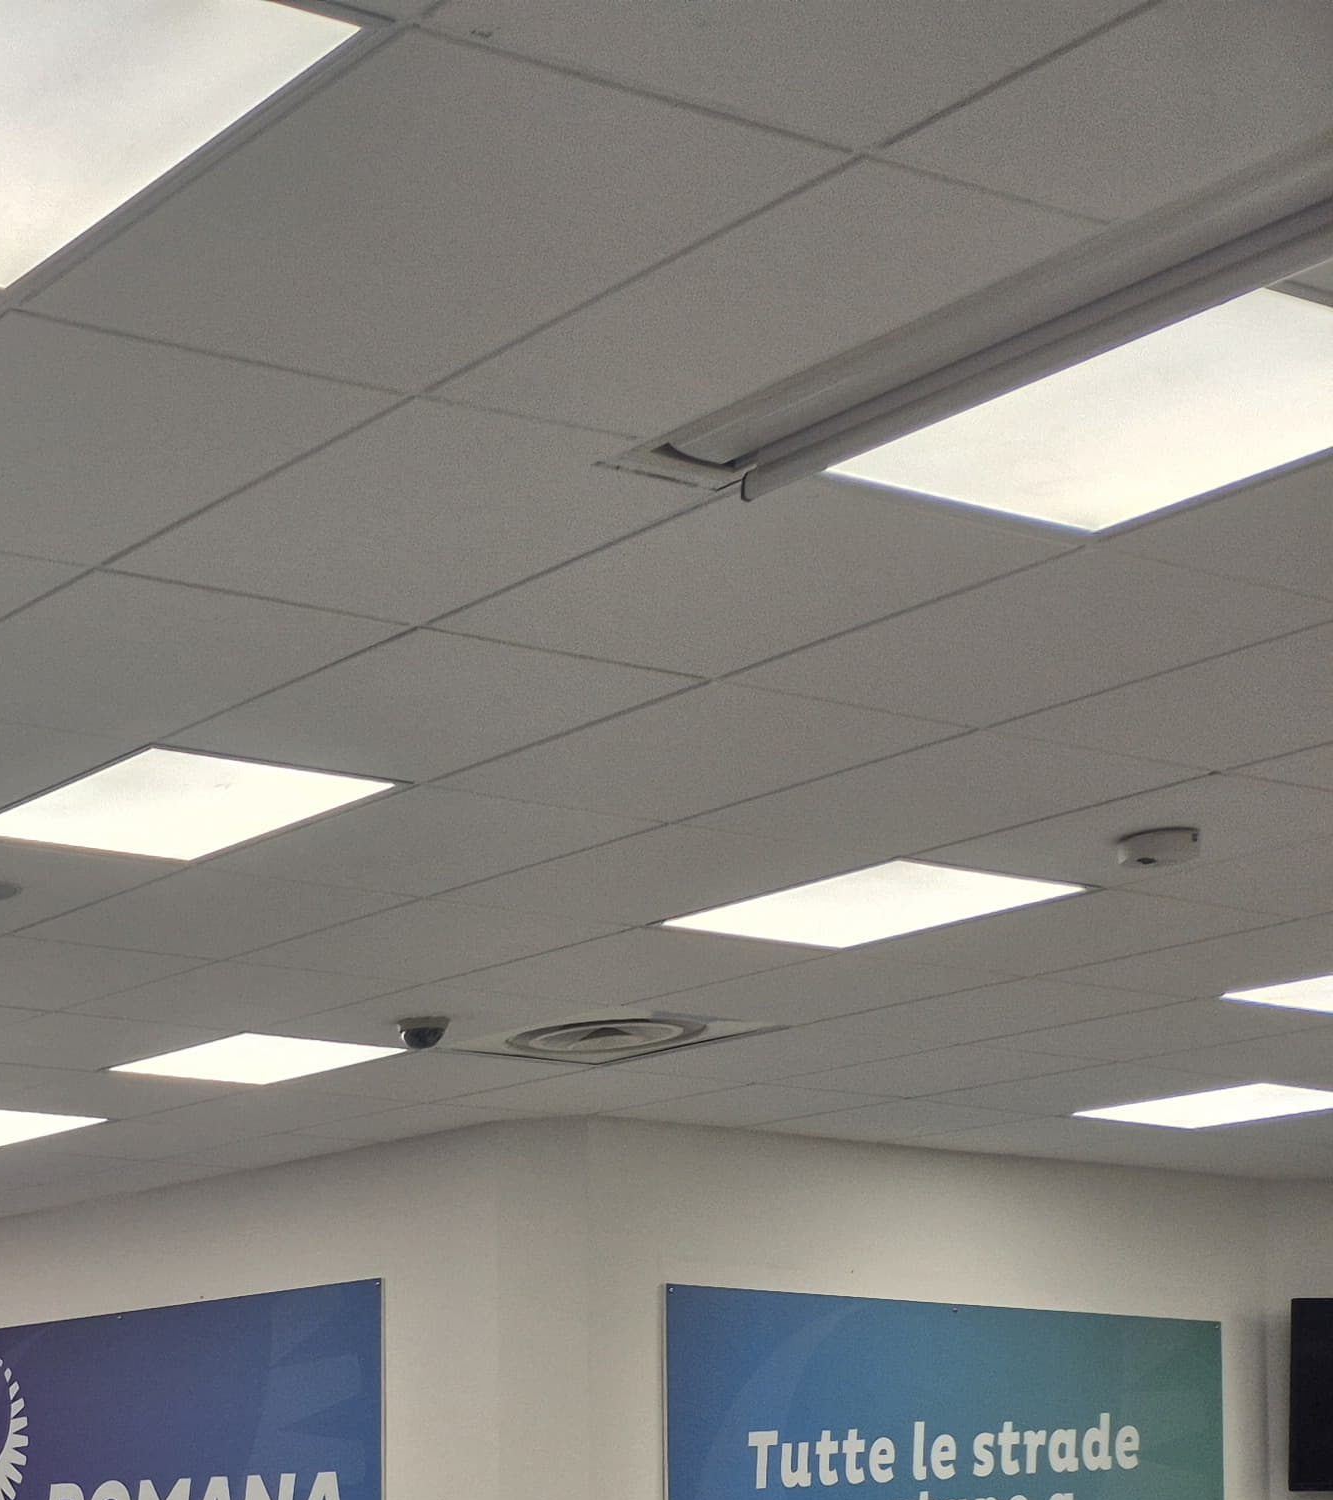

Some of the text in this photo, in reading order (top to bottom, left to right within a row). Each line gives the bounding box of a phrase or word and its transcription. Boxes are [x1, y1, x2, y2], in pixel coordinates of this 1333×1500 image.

[748, 1412, 1140, 1490] Tutte le strade
